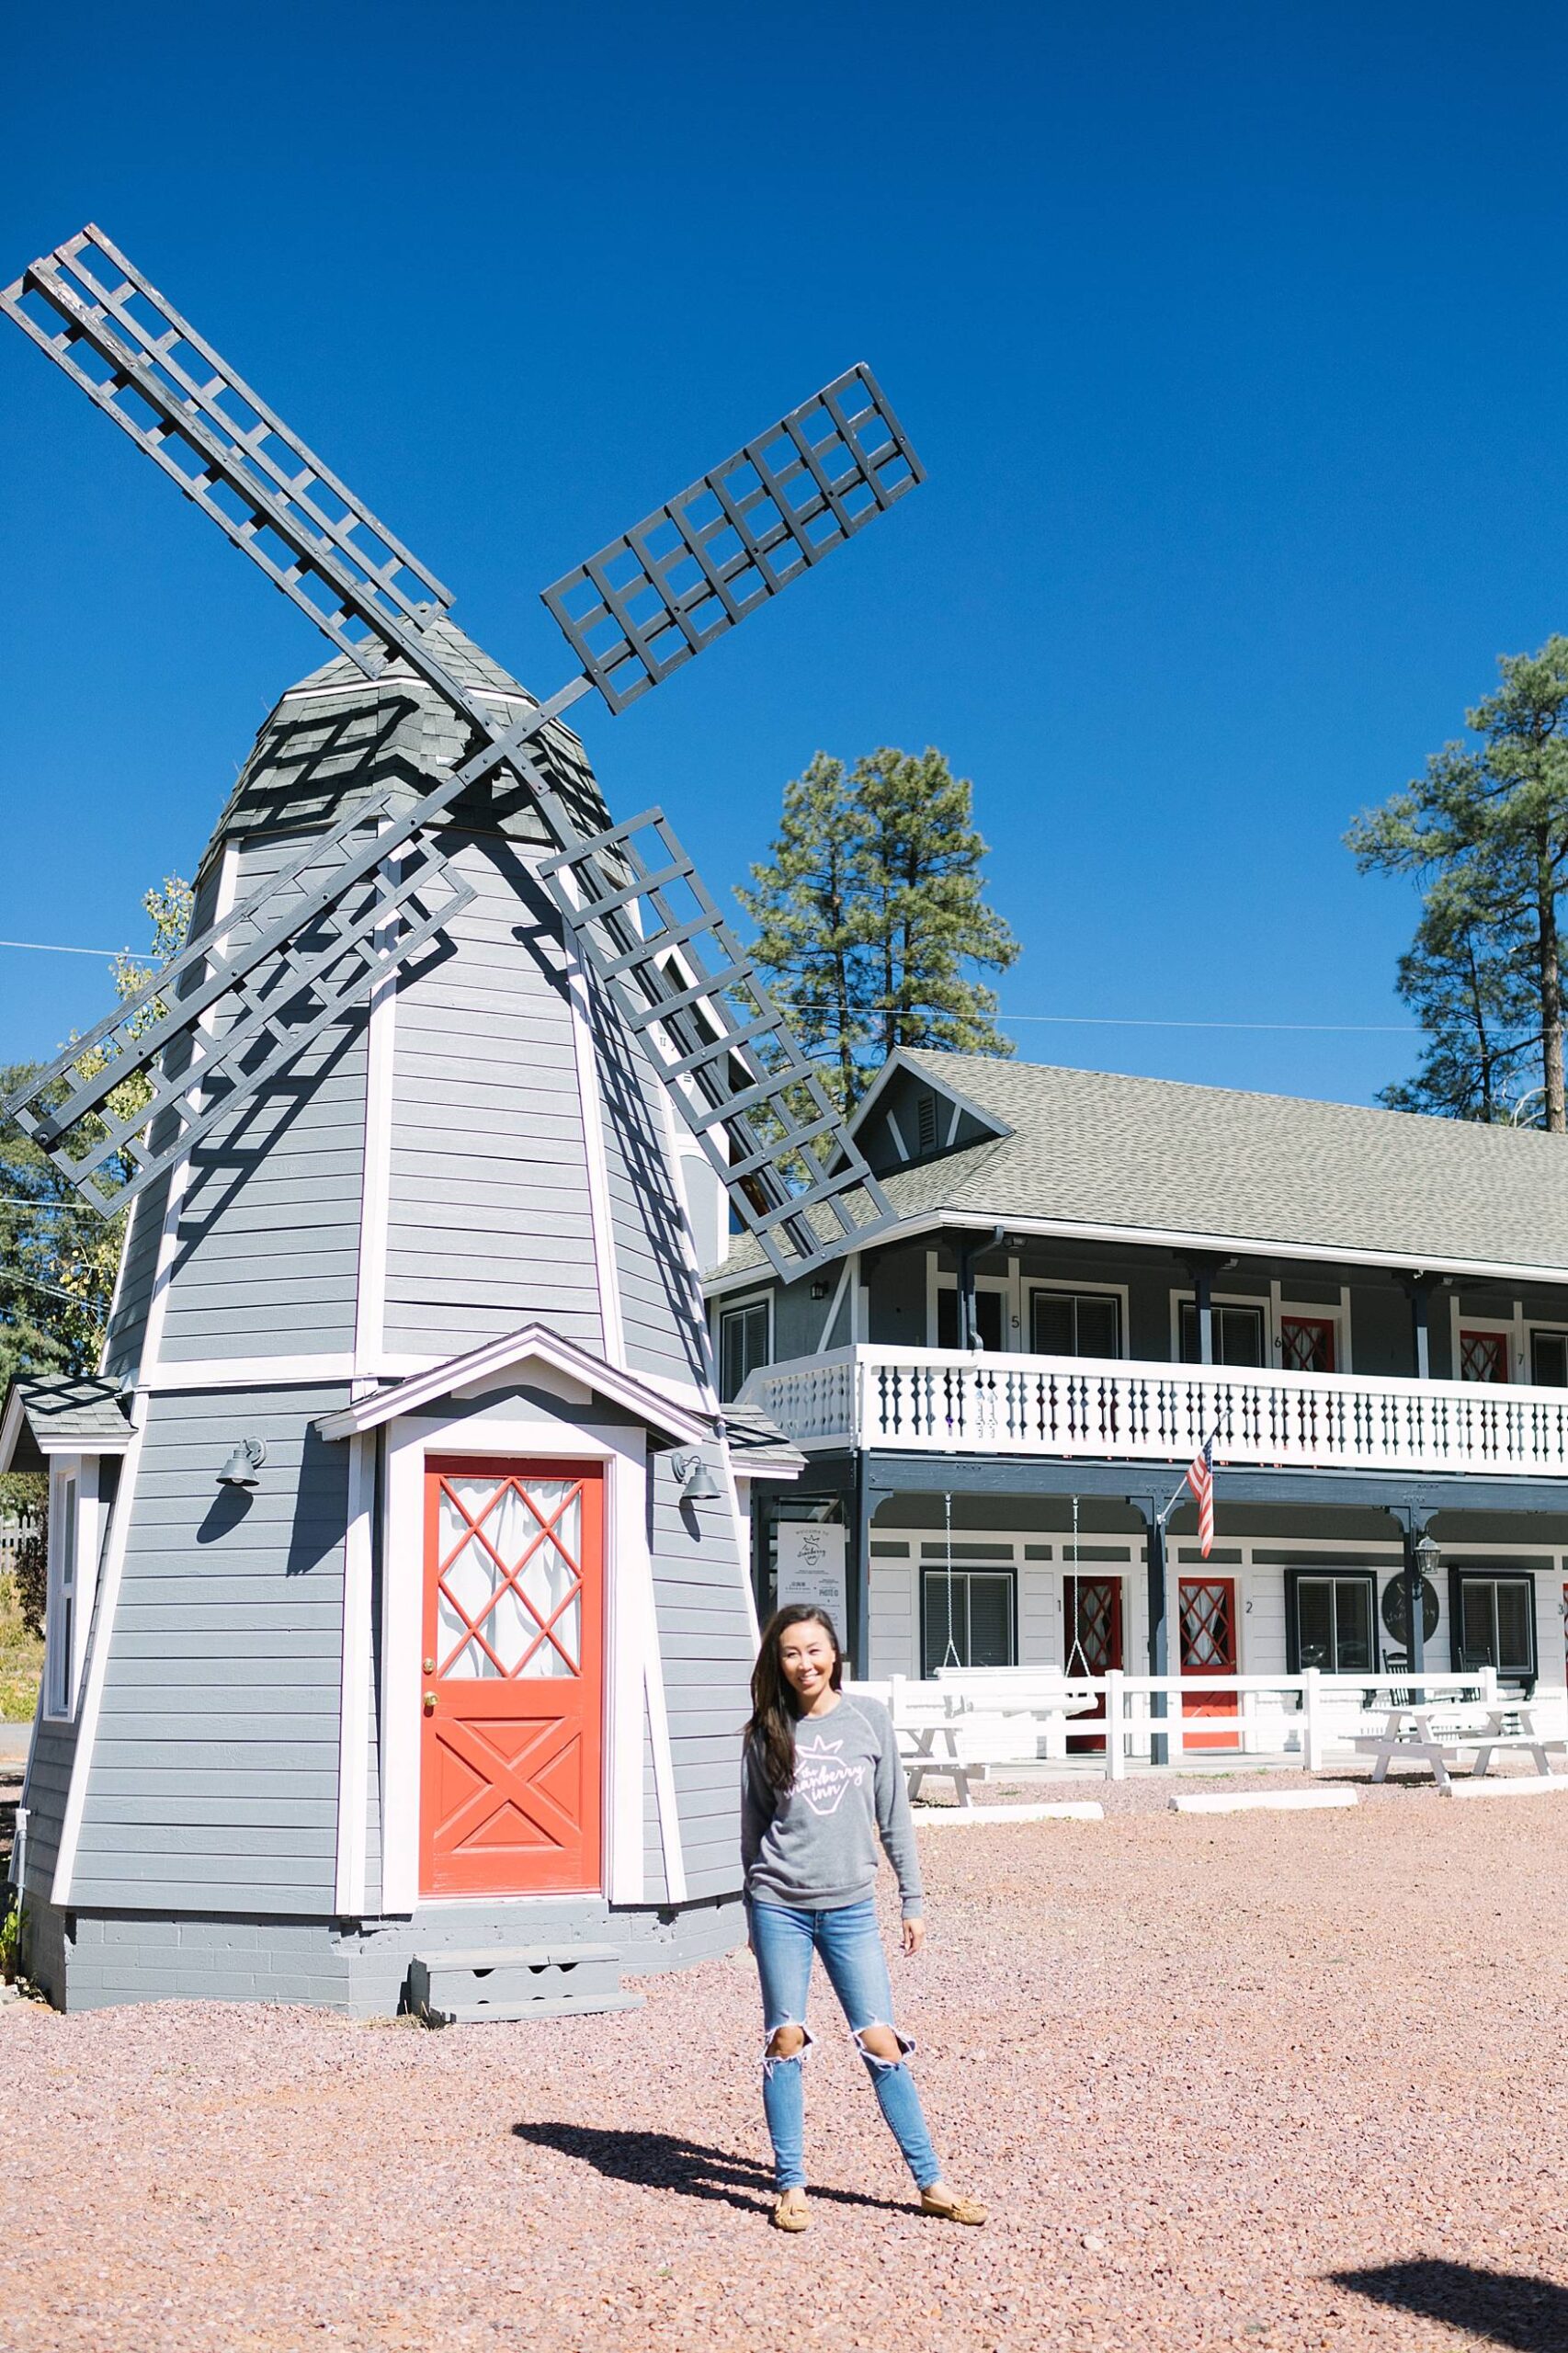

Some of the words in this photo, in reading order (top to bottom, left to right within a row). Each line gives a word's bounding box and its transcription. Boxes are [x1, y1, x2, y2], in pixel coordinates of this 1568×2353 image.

[1011, 1315, 1020, 1329] 5
[1274, 1336, 1282, 1348] 6
[1517, 1352, 1525, 1366] 7
[1245, 1601, 1253, 1614] 2
[1558, 1603, 1564, 1615] 3
[811, 1785, 841, 1802] inn
